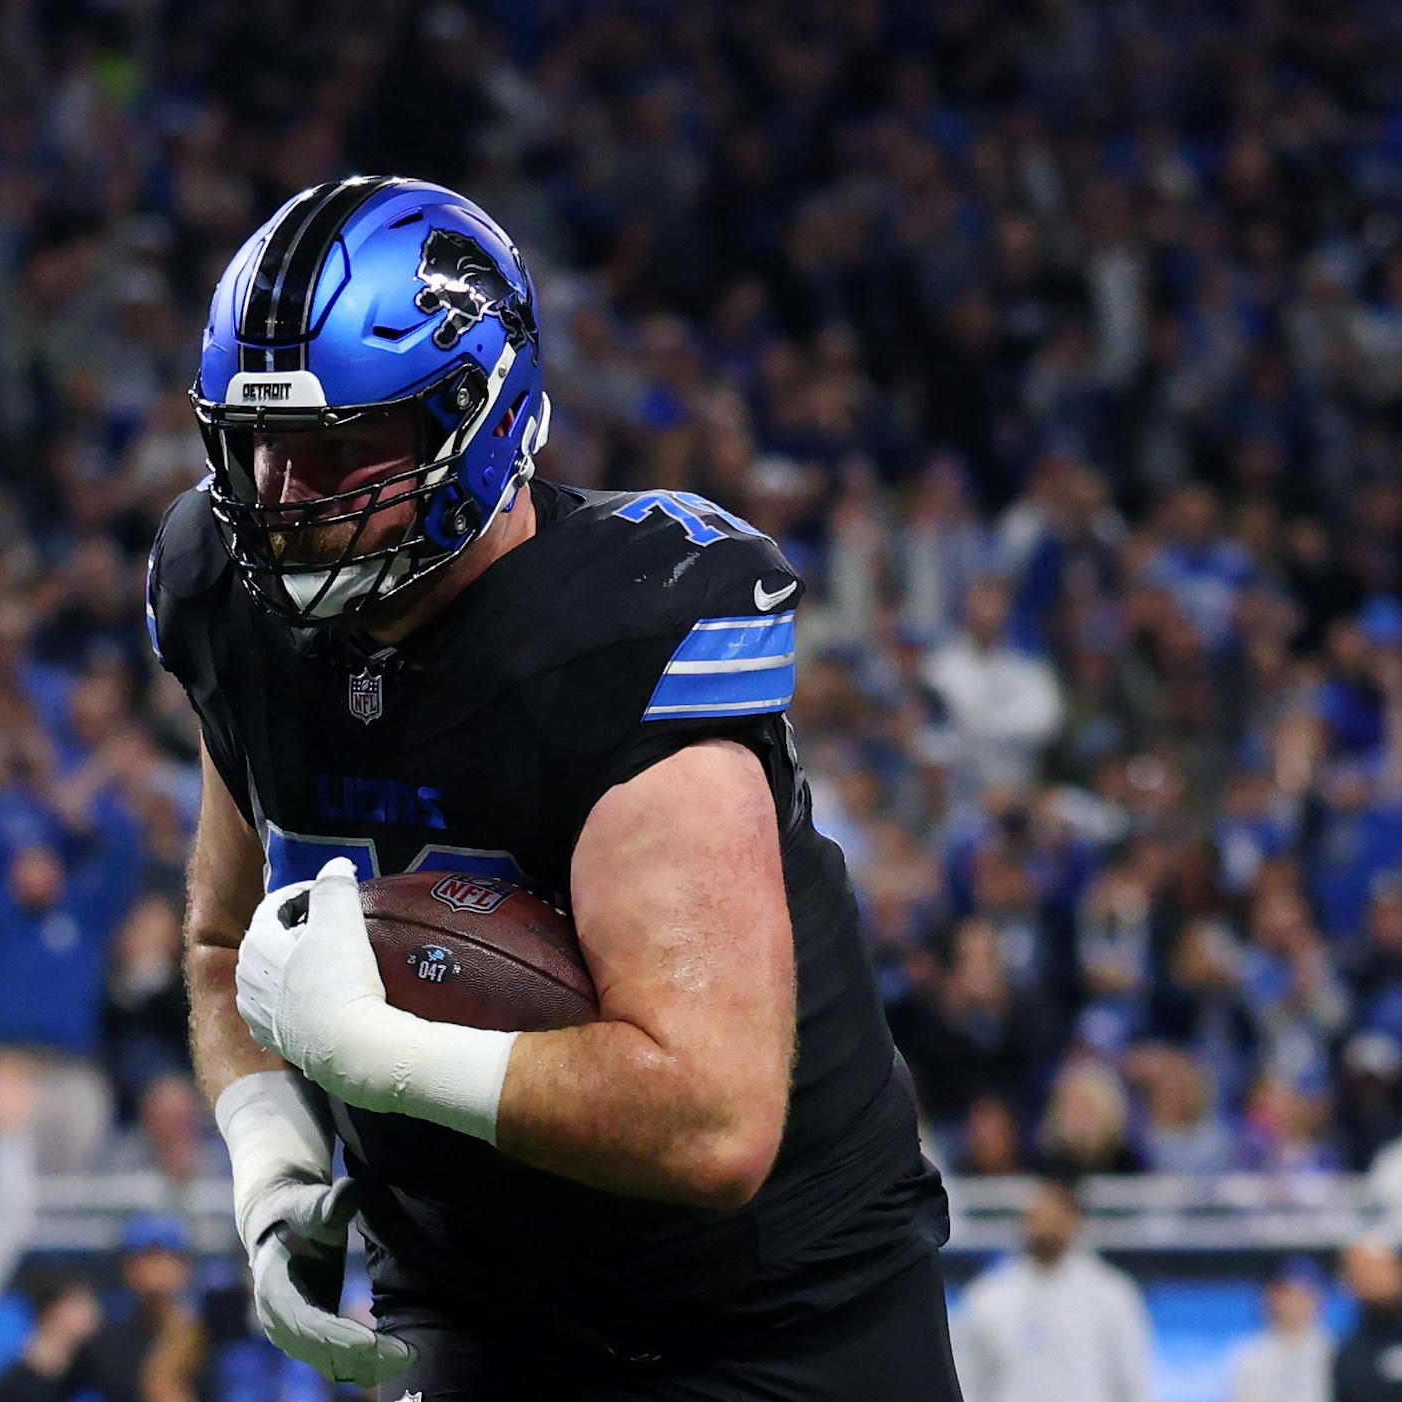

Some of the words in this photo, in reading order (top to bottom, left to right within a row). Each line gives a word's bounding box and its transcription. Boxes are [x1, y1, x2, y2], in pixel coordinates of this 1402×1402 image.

[243, 383, 292, 400] DETROIT
[440, 881, 494, 907] NFL
[418, 961, 447, 982] 047
